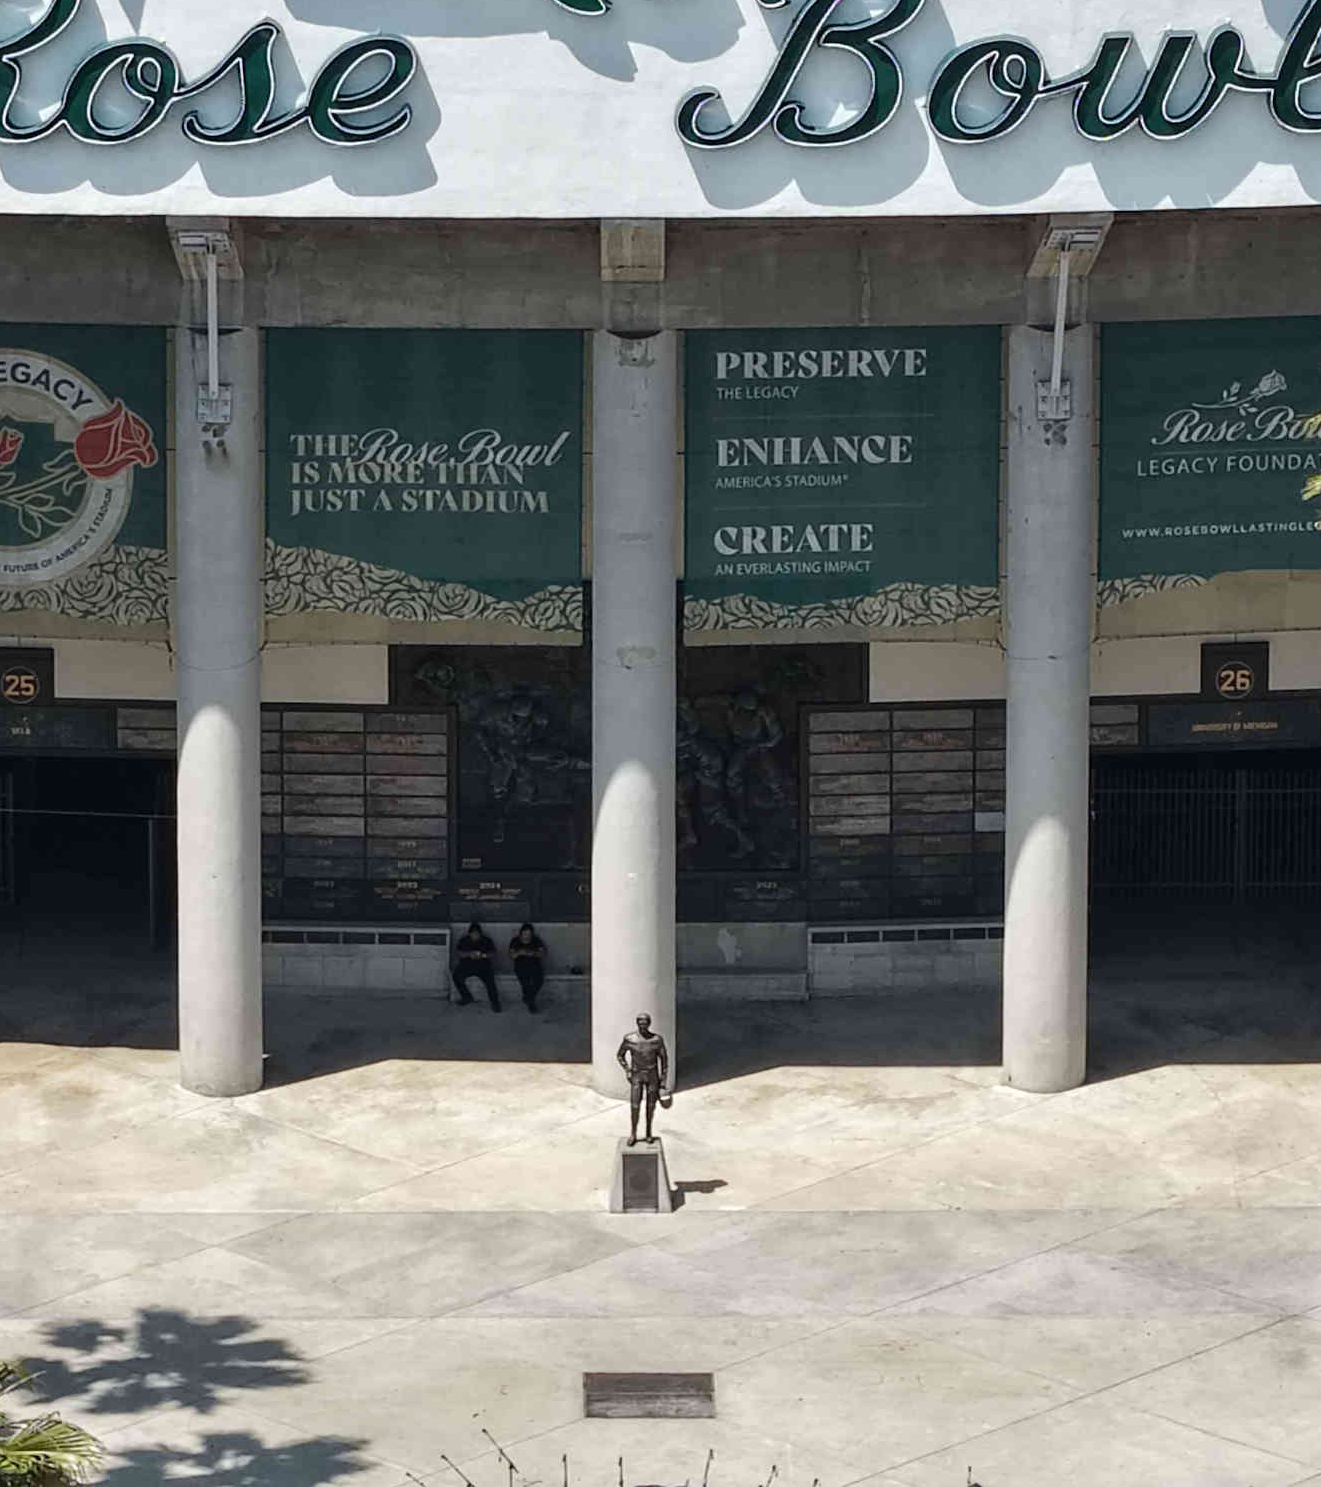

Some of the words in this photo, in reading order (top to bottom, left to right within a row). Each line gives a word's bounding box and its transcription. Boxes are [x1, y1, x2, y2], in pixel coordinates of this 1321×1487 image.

[716, 348, 927, 380] PRESERVE
[717, 386, 743, 401] THE
[745, 385, 800, 400] LEGACY
[1150, 408, 1247, 446] Rose
[290, 434, 359, 457] THE
[345, 427, 450, 466] Rose
[448, 427, 572, 467] Bowl
[717, 434, 914, 468] ENHANCE
[291, 461, 321, 485] IS
[327, 460, 425, 485] MORE
[436, 462, 526, 485] THAN
[1136, 456, 1219, 477] LEGACY
[715, 475, 782, 490] AMERICA'S
[289, 488, 366, 516] JUST
[373, 489, 393, 512] A
[401, 489, 551, 514] STADIUM
[713, 522, 875, 555] CREATE
[714, 563, 734, 577] AN
[736, 561, 822, 576] EVERLASTING
[823, 559, 872, 574] IMPACT
[5, 674, 36, 697] 25
[1219, 669, 1251, 692] 26
